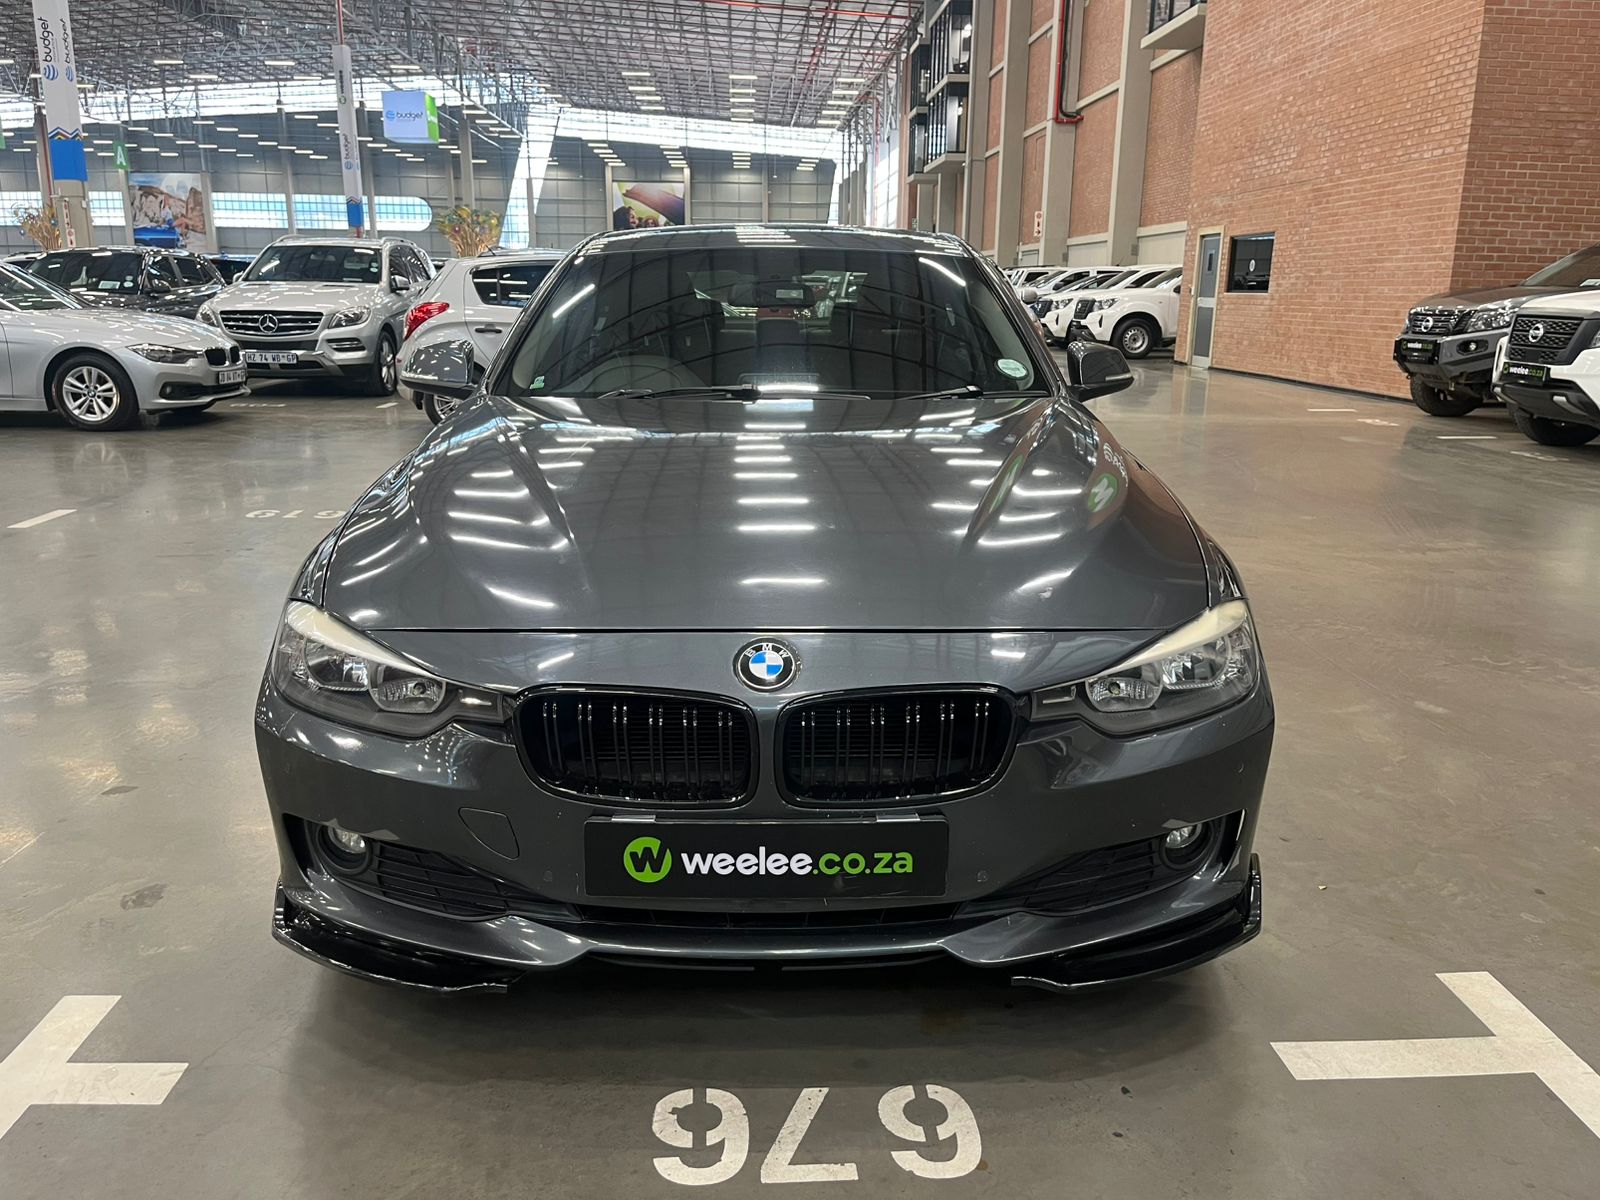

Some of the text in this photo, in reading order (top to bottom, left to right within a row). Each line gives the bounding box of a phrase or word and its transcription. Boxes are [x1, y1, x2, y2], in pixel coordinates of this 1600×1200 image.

[37, 16, 54, 63] budget
[59, 17, 71, 64] budget
[396, 111, 424, 122] budget
[116, 145, 127, 166] A
[342, 133, 351, 160] budget
[286, 354, 296, 363] GP
[744, 642, 790, 659] BMW
[680, 846, 914, 876] weelee.co.za
